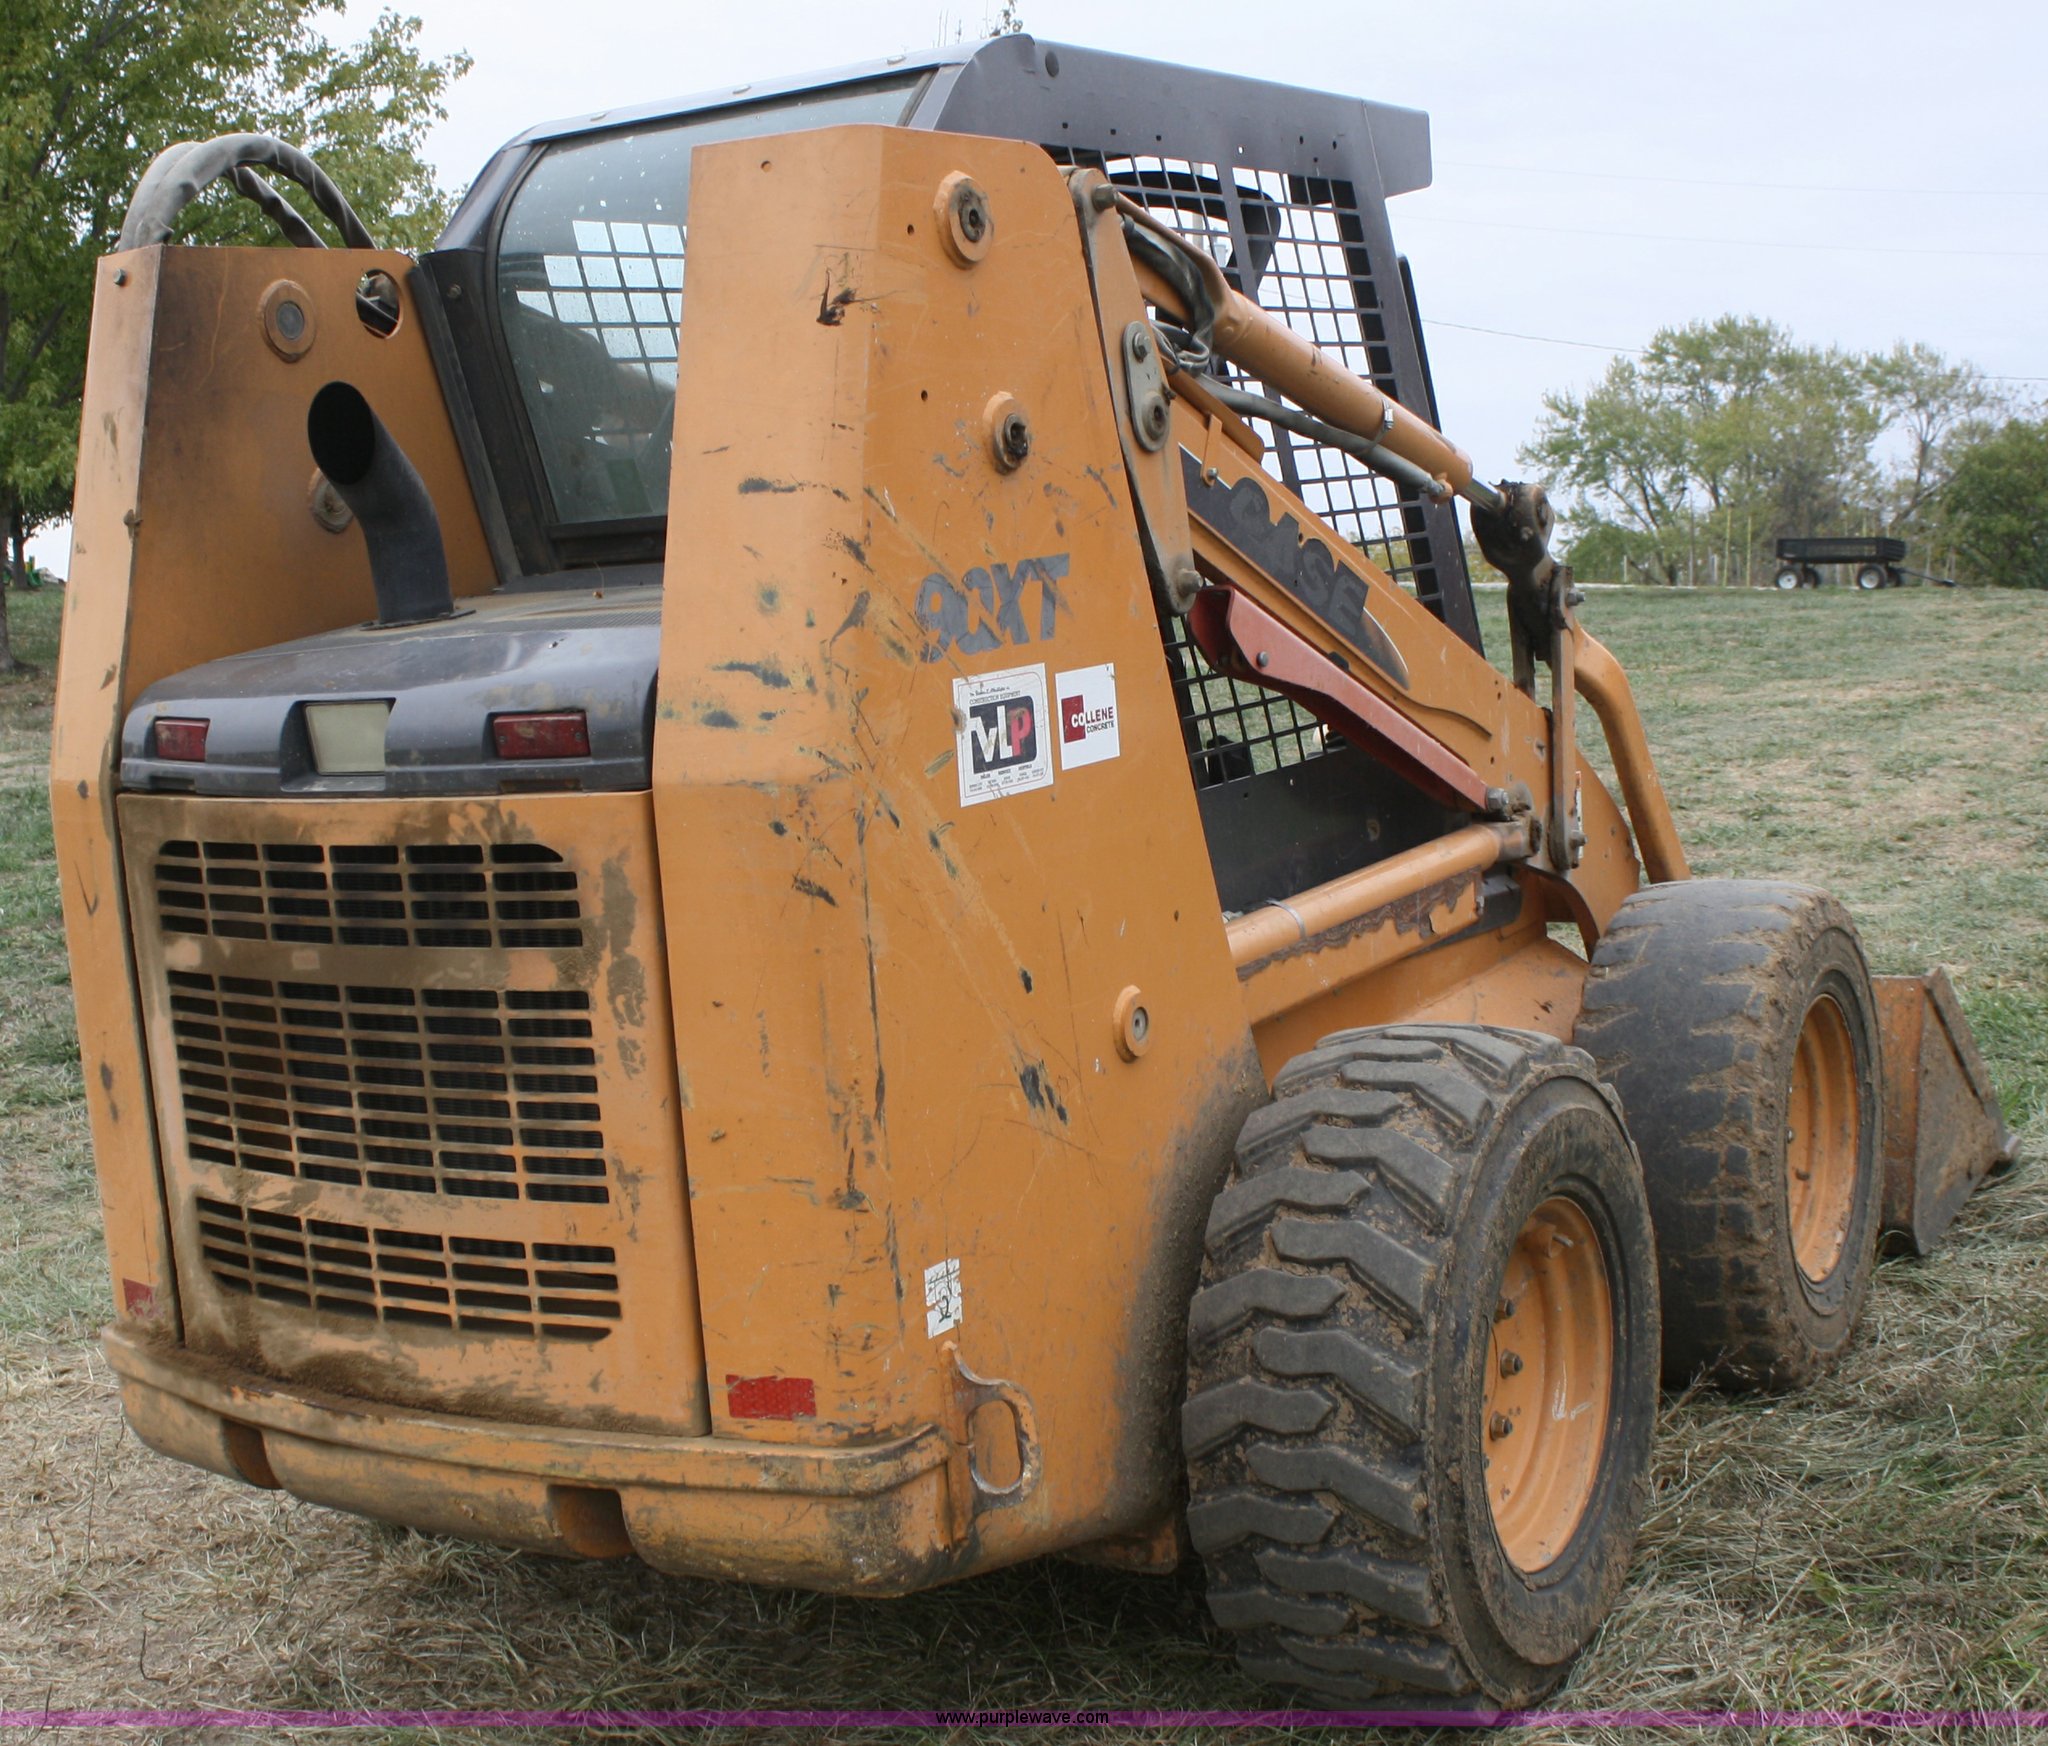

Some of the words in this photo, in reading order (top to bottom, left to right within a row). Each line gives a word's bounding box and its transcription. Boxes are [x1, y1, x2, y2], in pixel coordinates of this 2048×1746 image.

[1230, 479, 1368, 637] CASE
[1071, 706, 1114, 728] COLLENE
[1087, 720, 1114, 733] CONCRETE
